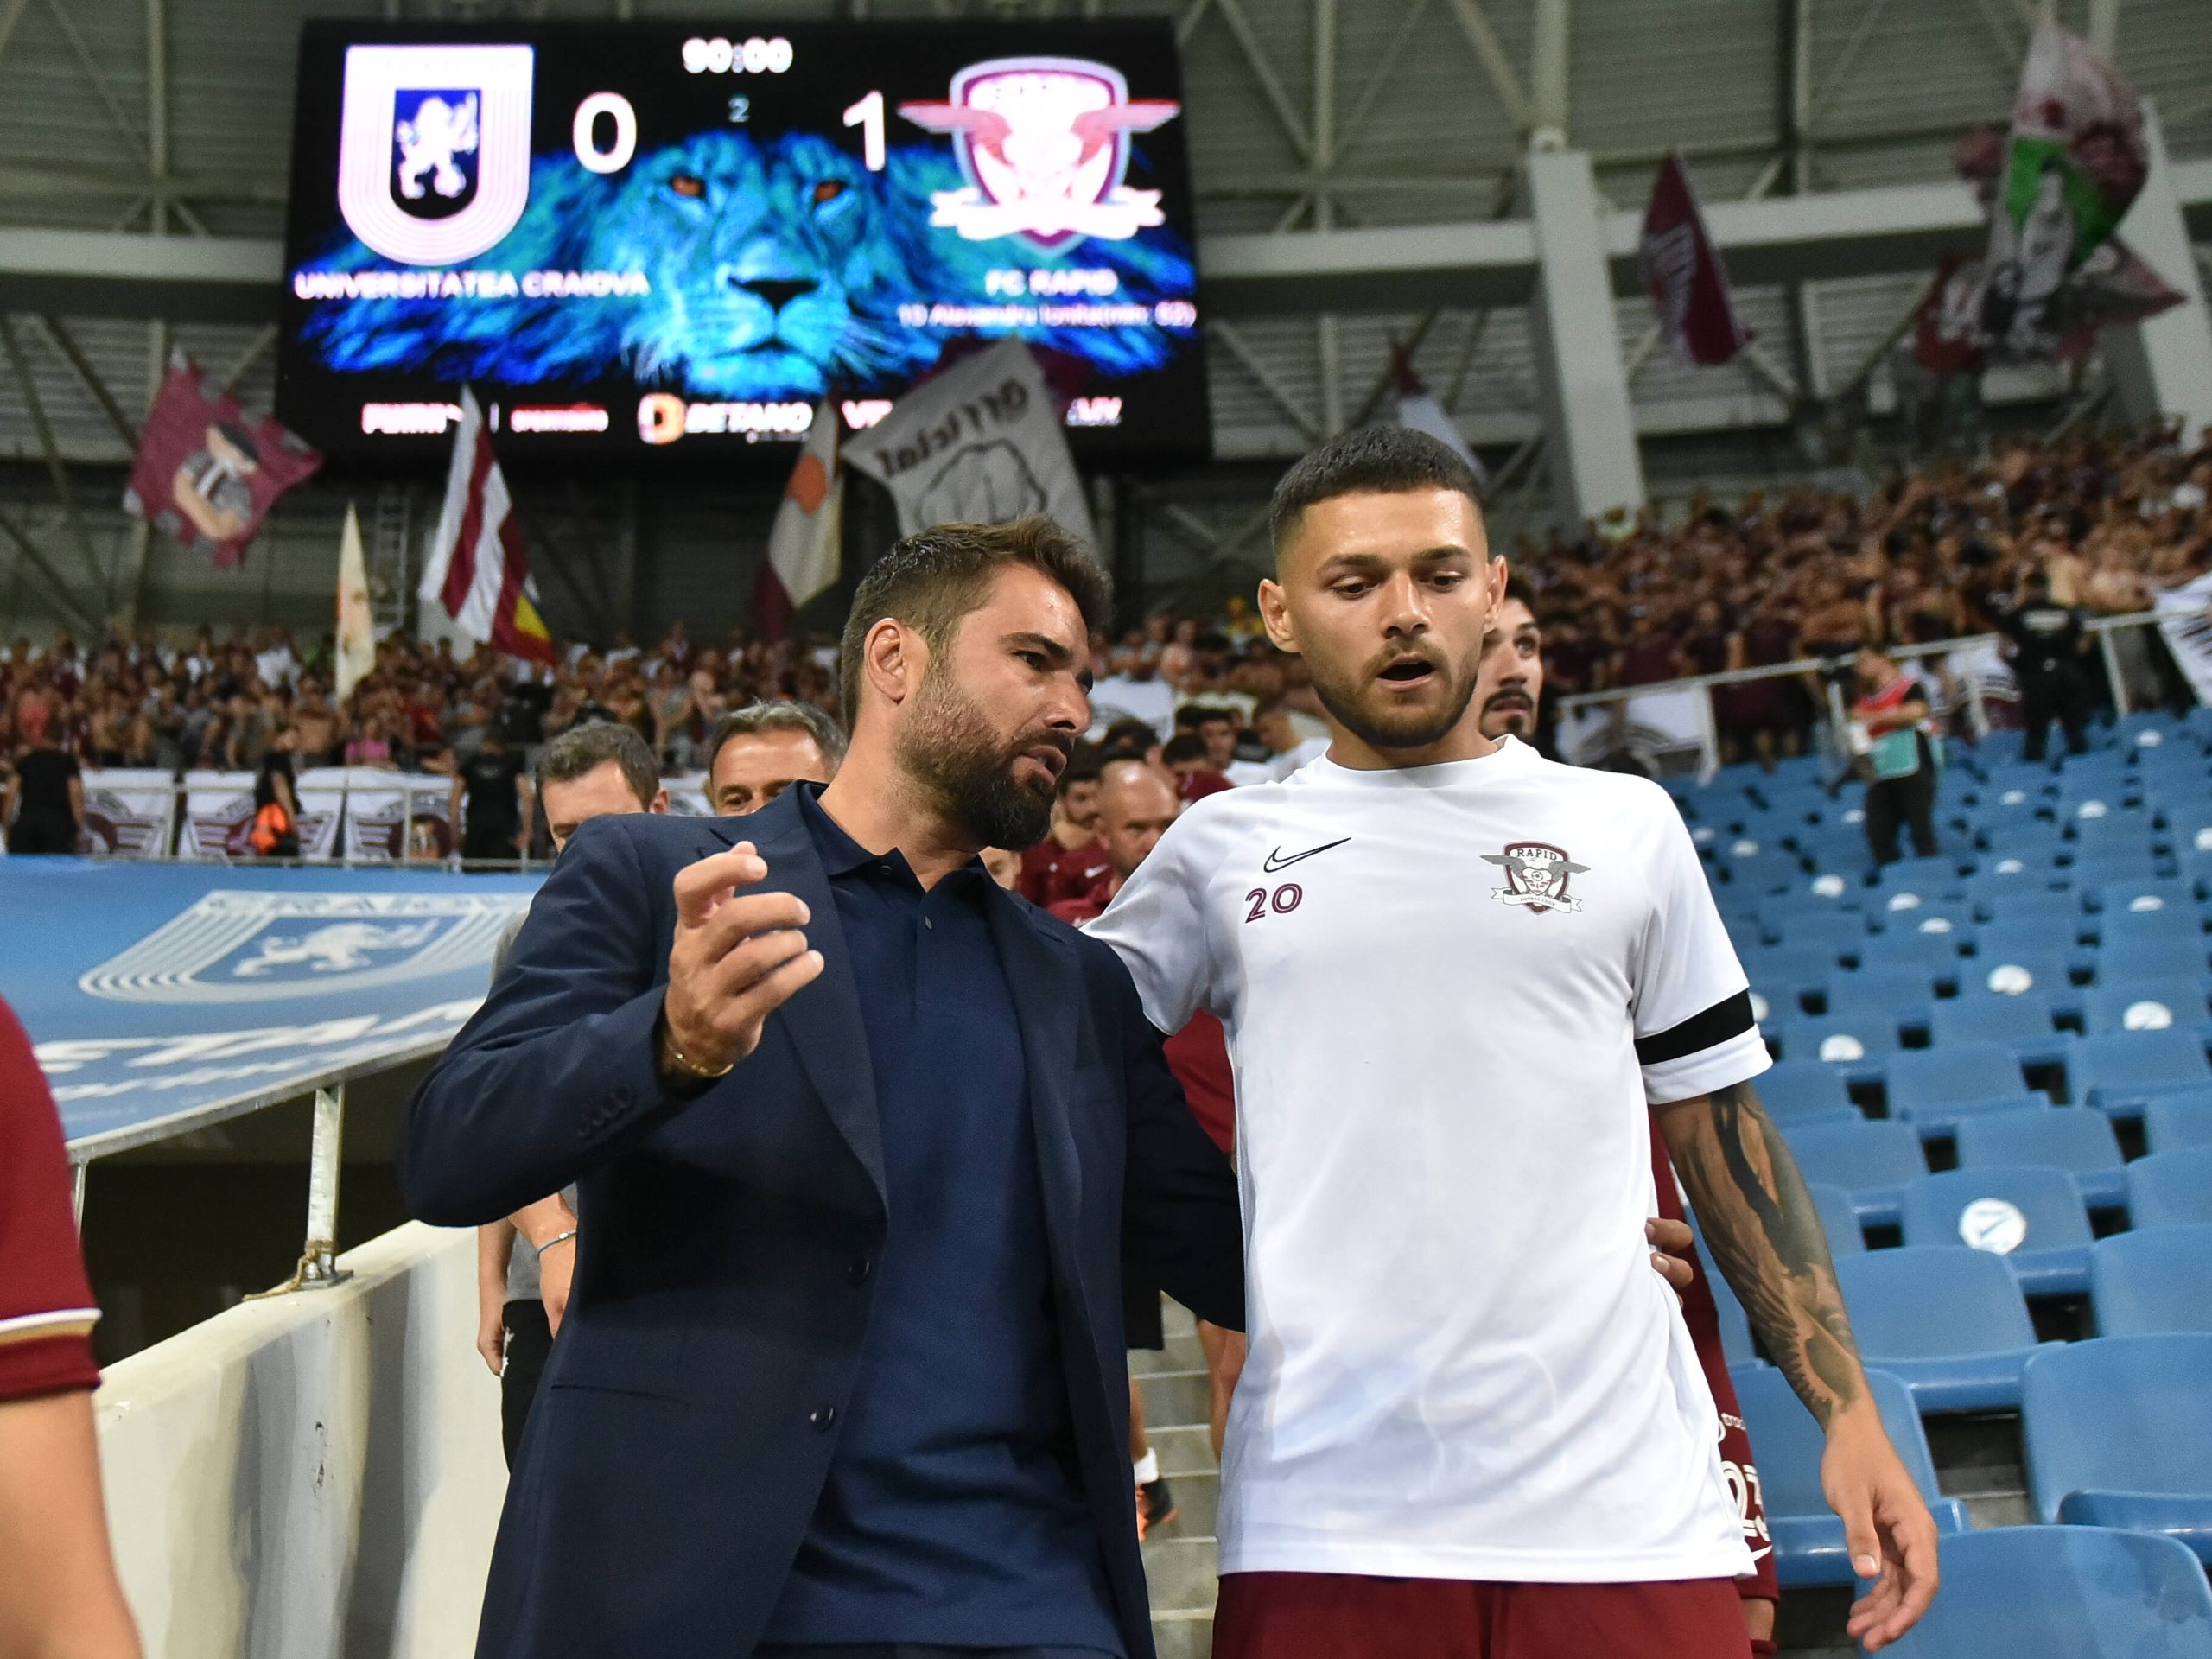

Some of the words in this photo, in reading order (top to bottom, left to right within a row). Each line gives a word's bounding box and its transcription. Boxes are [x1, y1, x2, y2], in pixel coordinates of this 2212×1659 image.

[728, 93, 750, 123] 2
[573, 92, 637, 173] 0
[843, 90, 885, 171] 1
[294, 271, 518, 299] UNIVERSITATEA
[522, 271, 651, 298] CRAIOVA
[985, 269, 1026, 296] FC
[1029, 269, 1118, 296] RAPID
[1516, 849, 1557, 861] RAPID
[1245, 883, 1303, 923] 20
